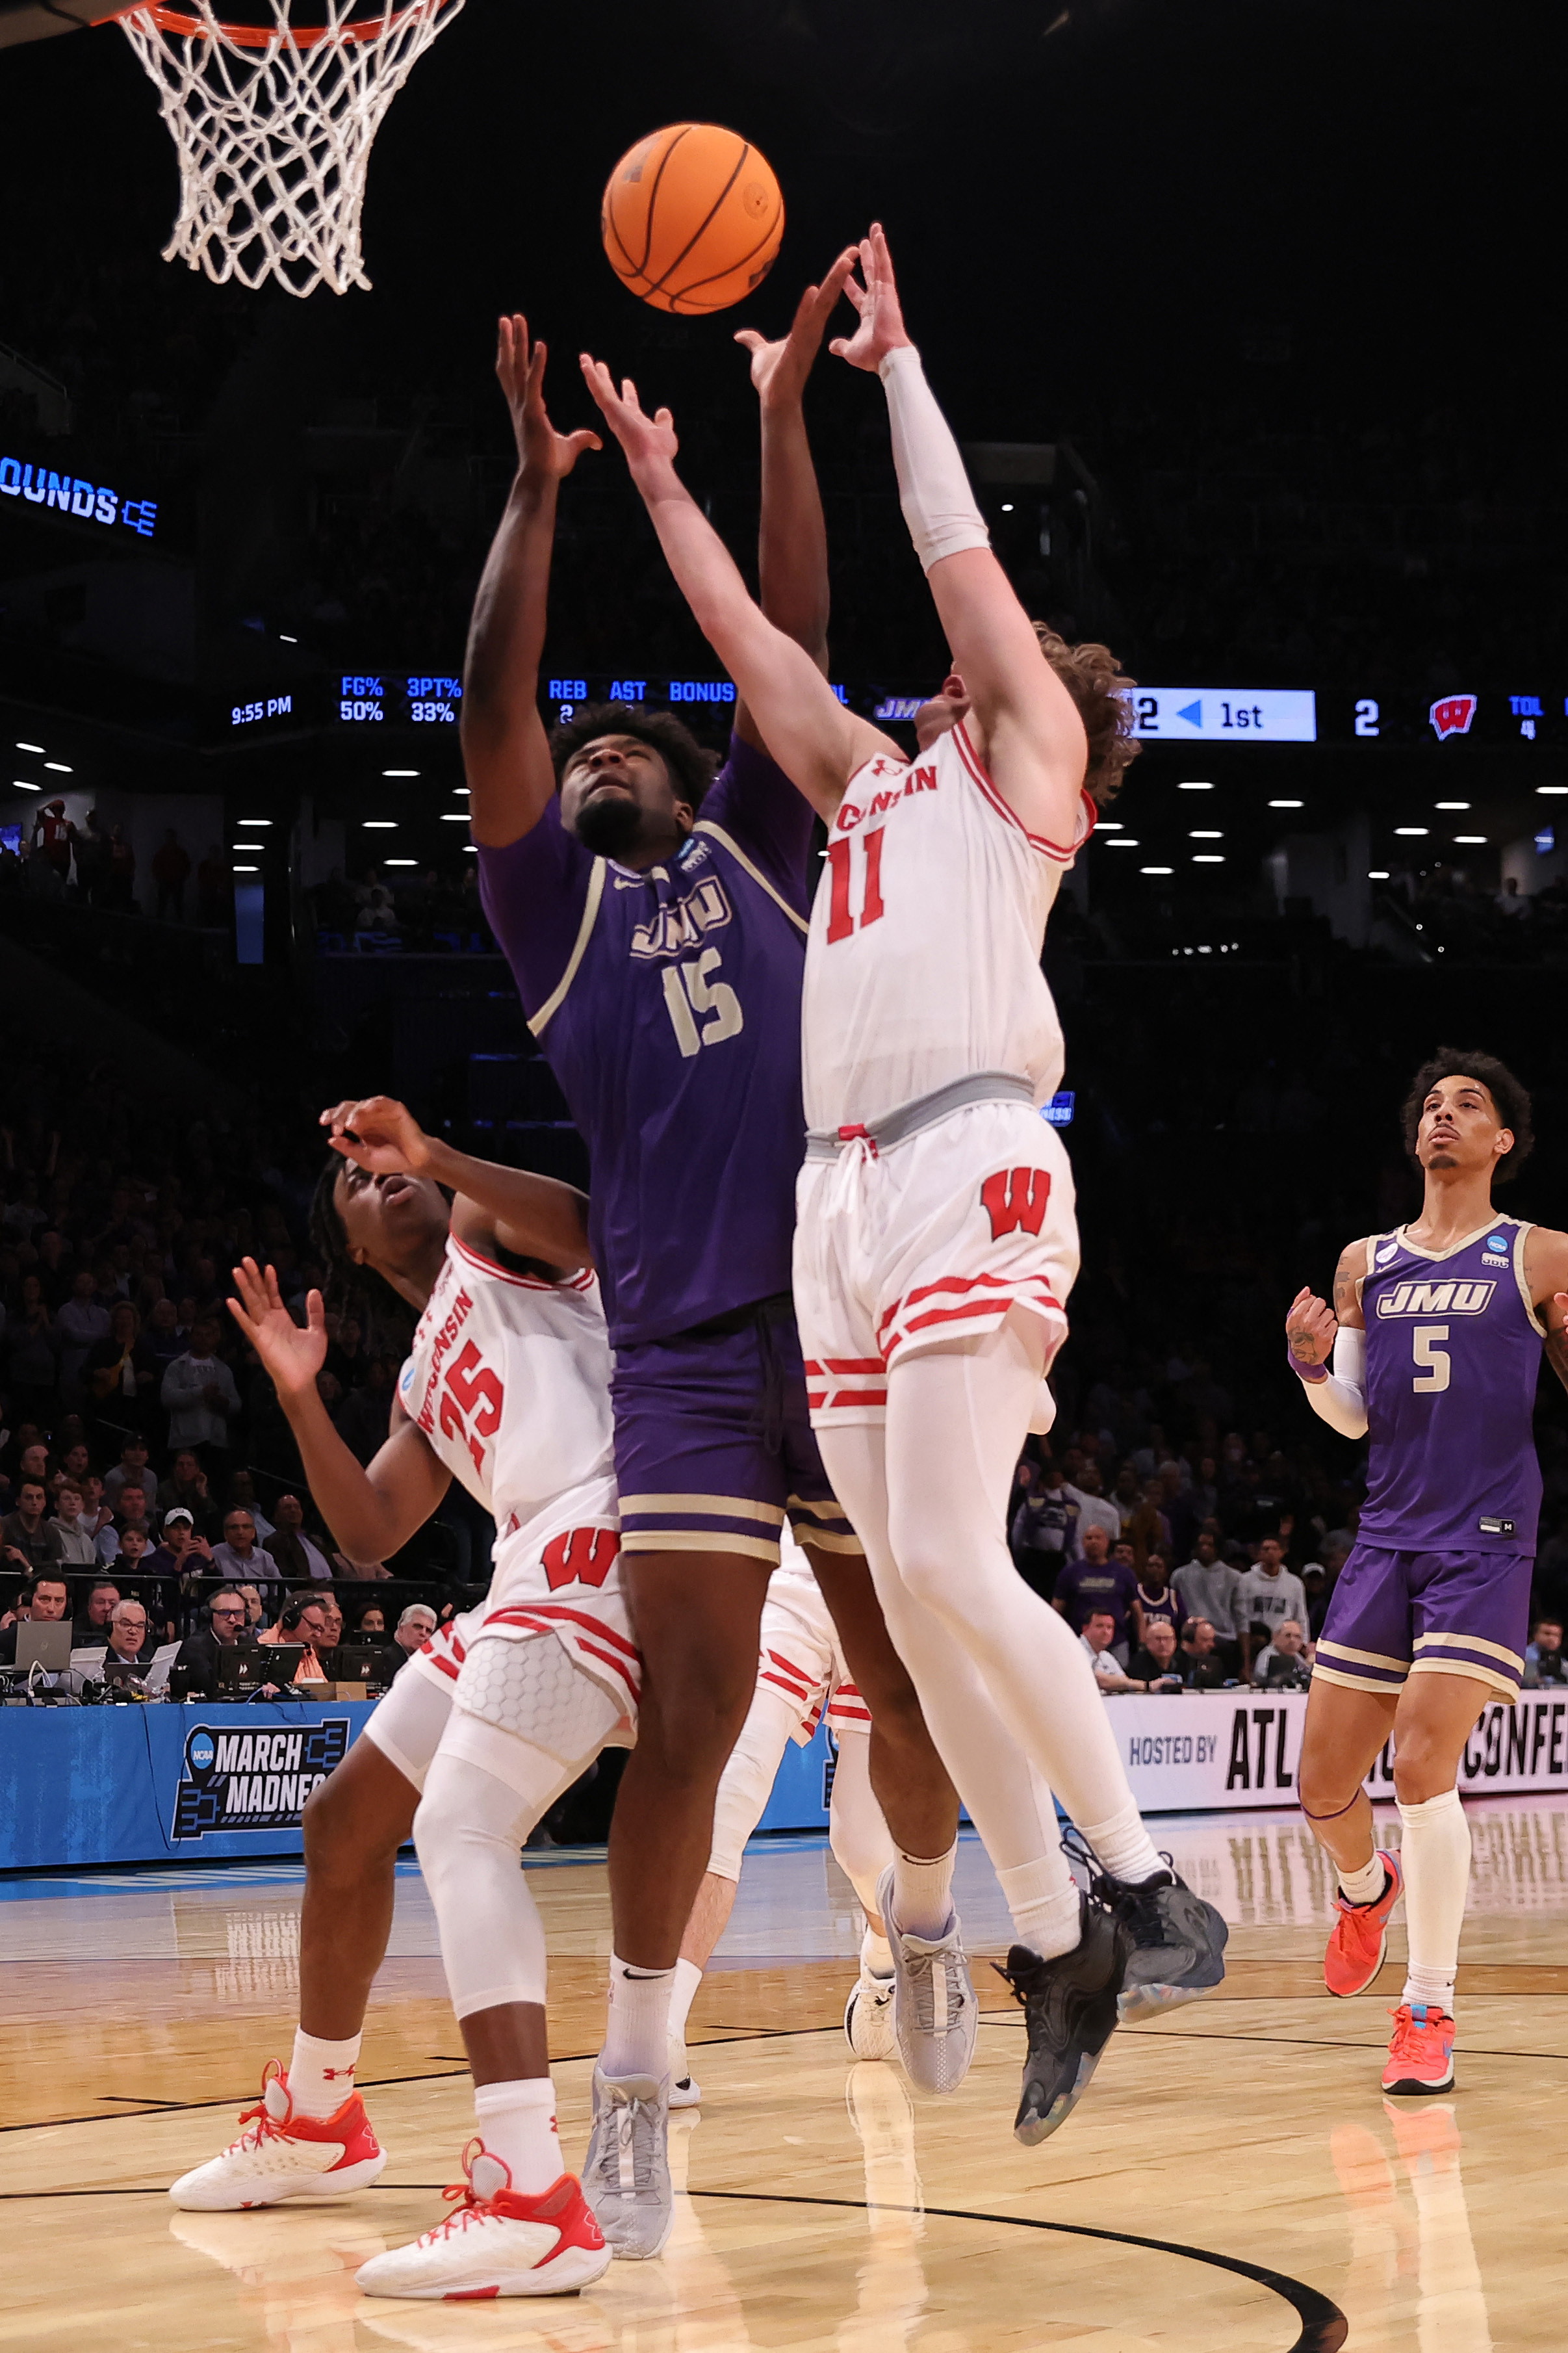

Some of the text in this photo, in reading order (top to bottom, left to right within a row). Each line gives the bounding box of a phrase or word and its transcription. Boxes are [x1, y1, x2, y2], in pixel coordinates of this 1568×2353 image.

[0, 456, 118, 525] OUNDS
[341, 677, 736, 702] FG% 3PT% REB AST BONUS
[876, 698, 928, 720] JM
[231, 695, 292, 725] 9:55 PM
[340, 701, 383, 721] 50%
[411, 702, 455, 722] 33%
[1220, 703, 1263, 729] 1st
[1354, 699, 1380, 736] 2
[826, 826, 886, 946] 11
[630, 877, 732, 959] JMU
[662, 946, 743, 1058] 15
[981, 1167, 1051, 1243] W
[1377, 1279, 1497, 1319] JMU
[1413, 1325, 1450, 1393] 5
[440, 1338, 504, 1487] 25
[540, 1527, 621, 1592] W
[214, 1734, 303, 1773] MARCH
[1129, 1735, 1218, 1766] HOSTED BY
